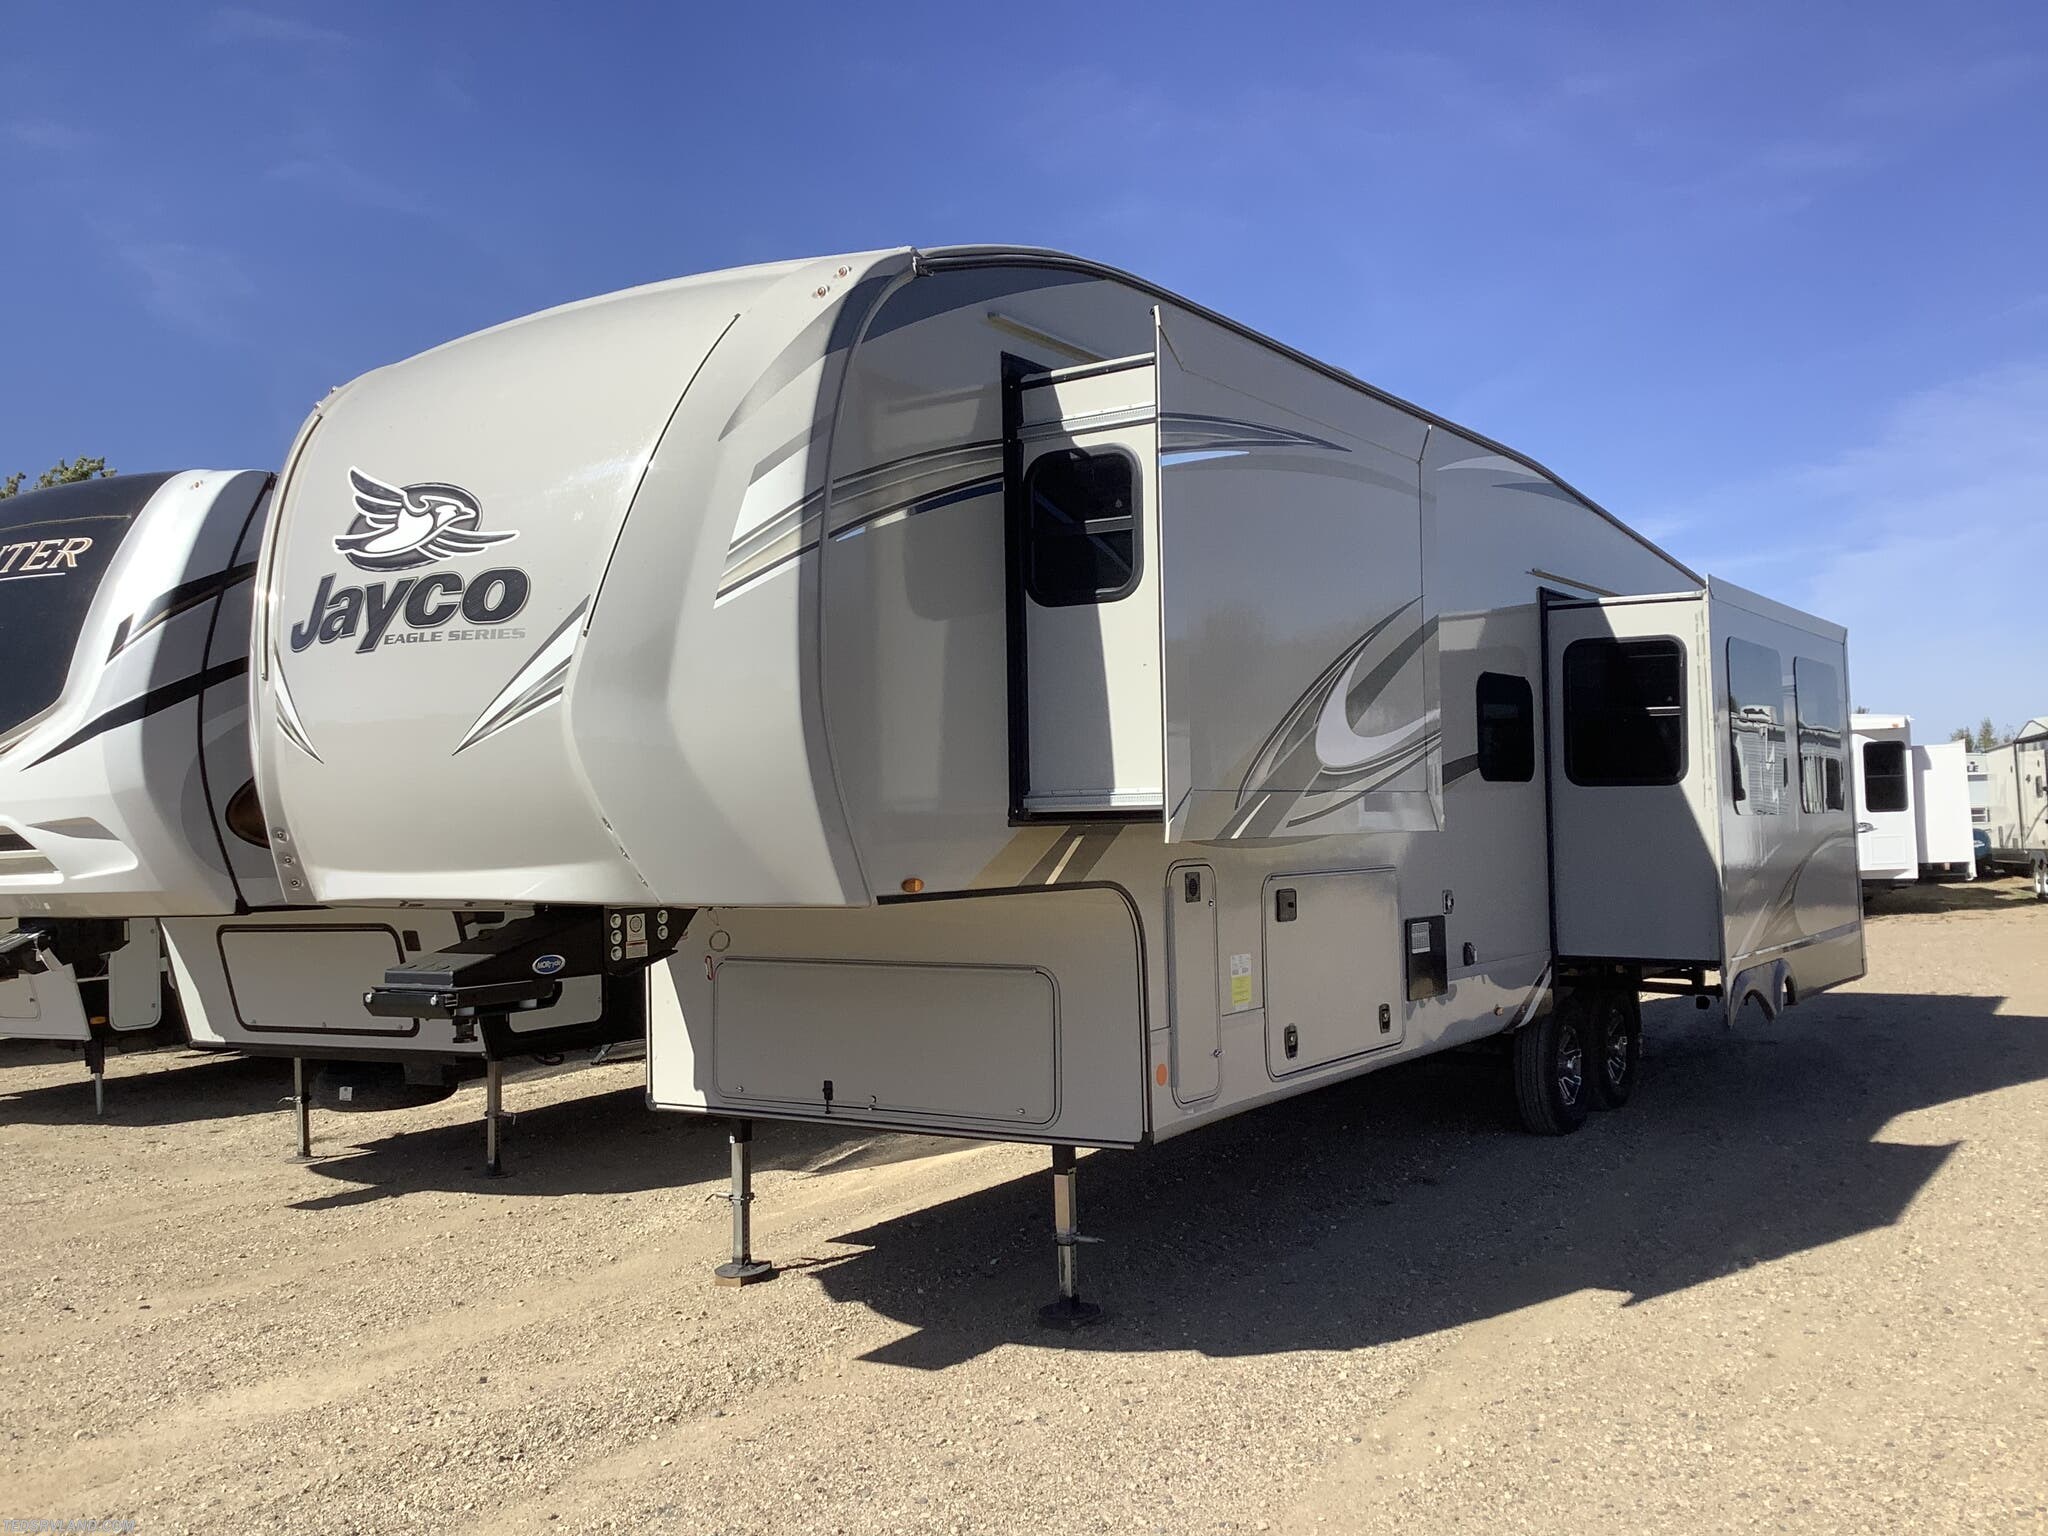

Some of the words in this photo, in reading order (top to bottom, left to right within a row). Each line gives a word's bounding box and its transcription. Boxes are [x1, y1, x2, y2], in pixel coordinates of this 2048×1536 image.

[0, 537, 94, 573] TER
[290, 566, 532, 654] Jayco
[383, 631, 444, 646] EAGLE
[447, 627, 527, 643] SERIES
